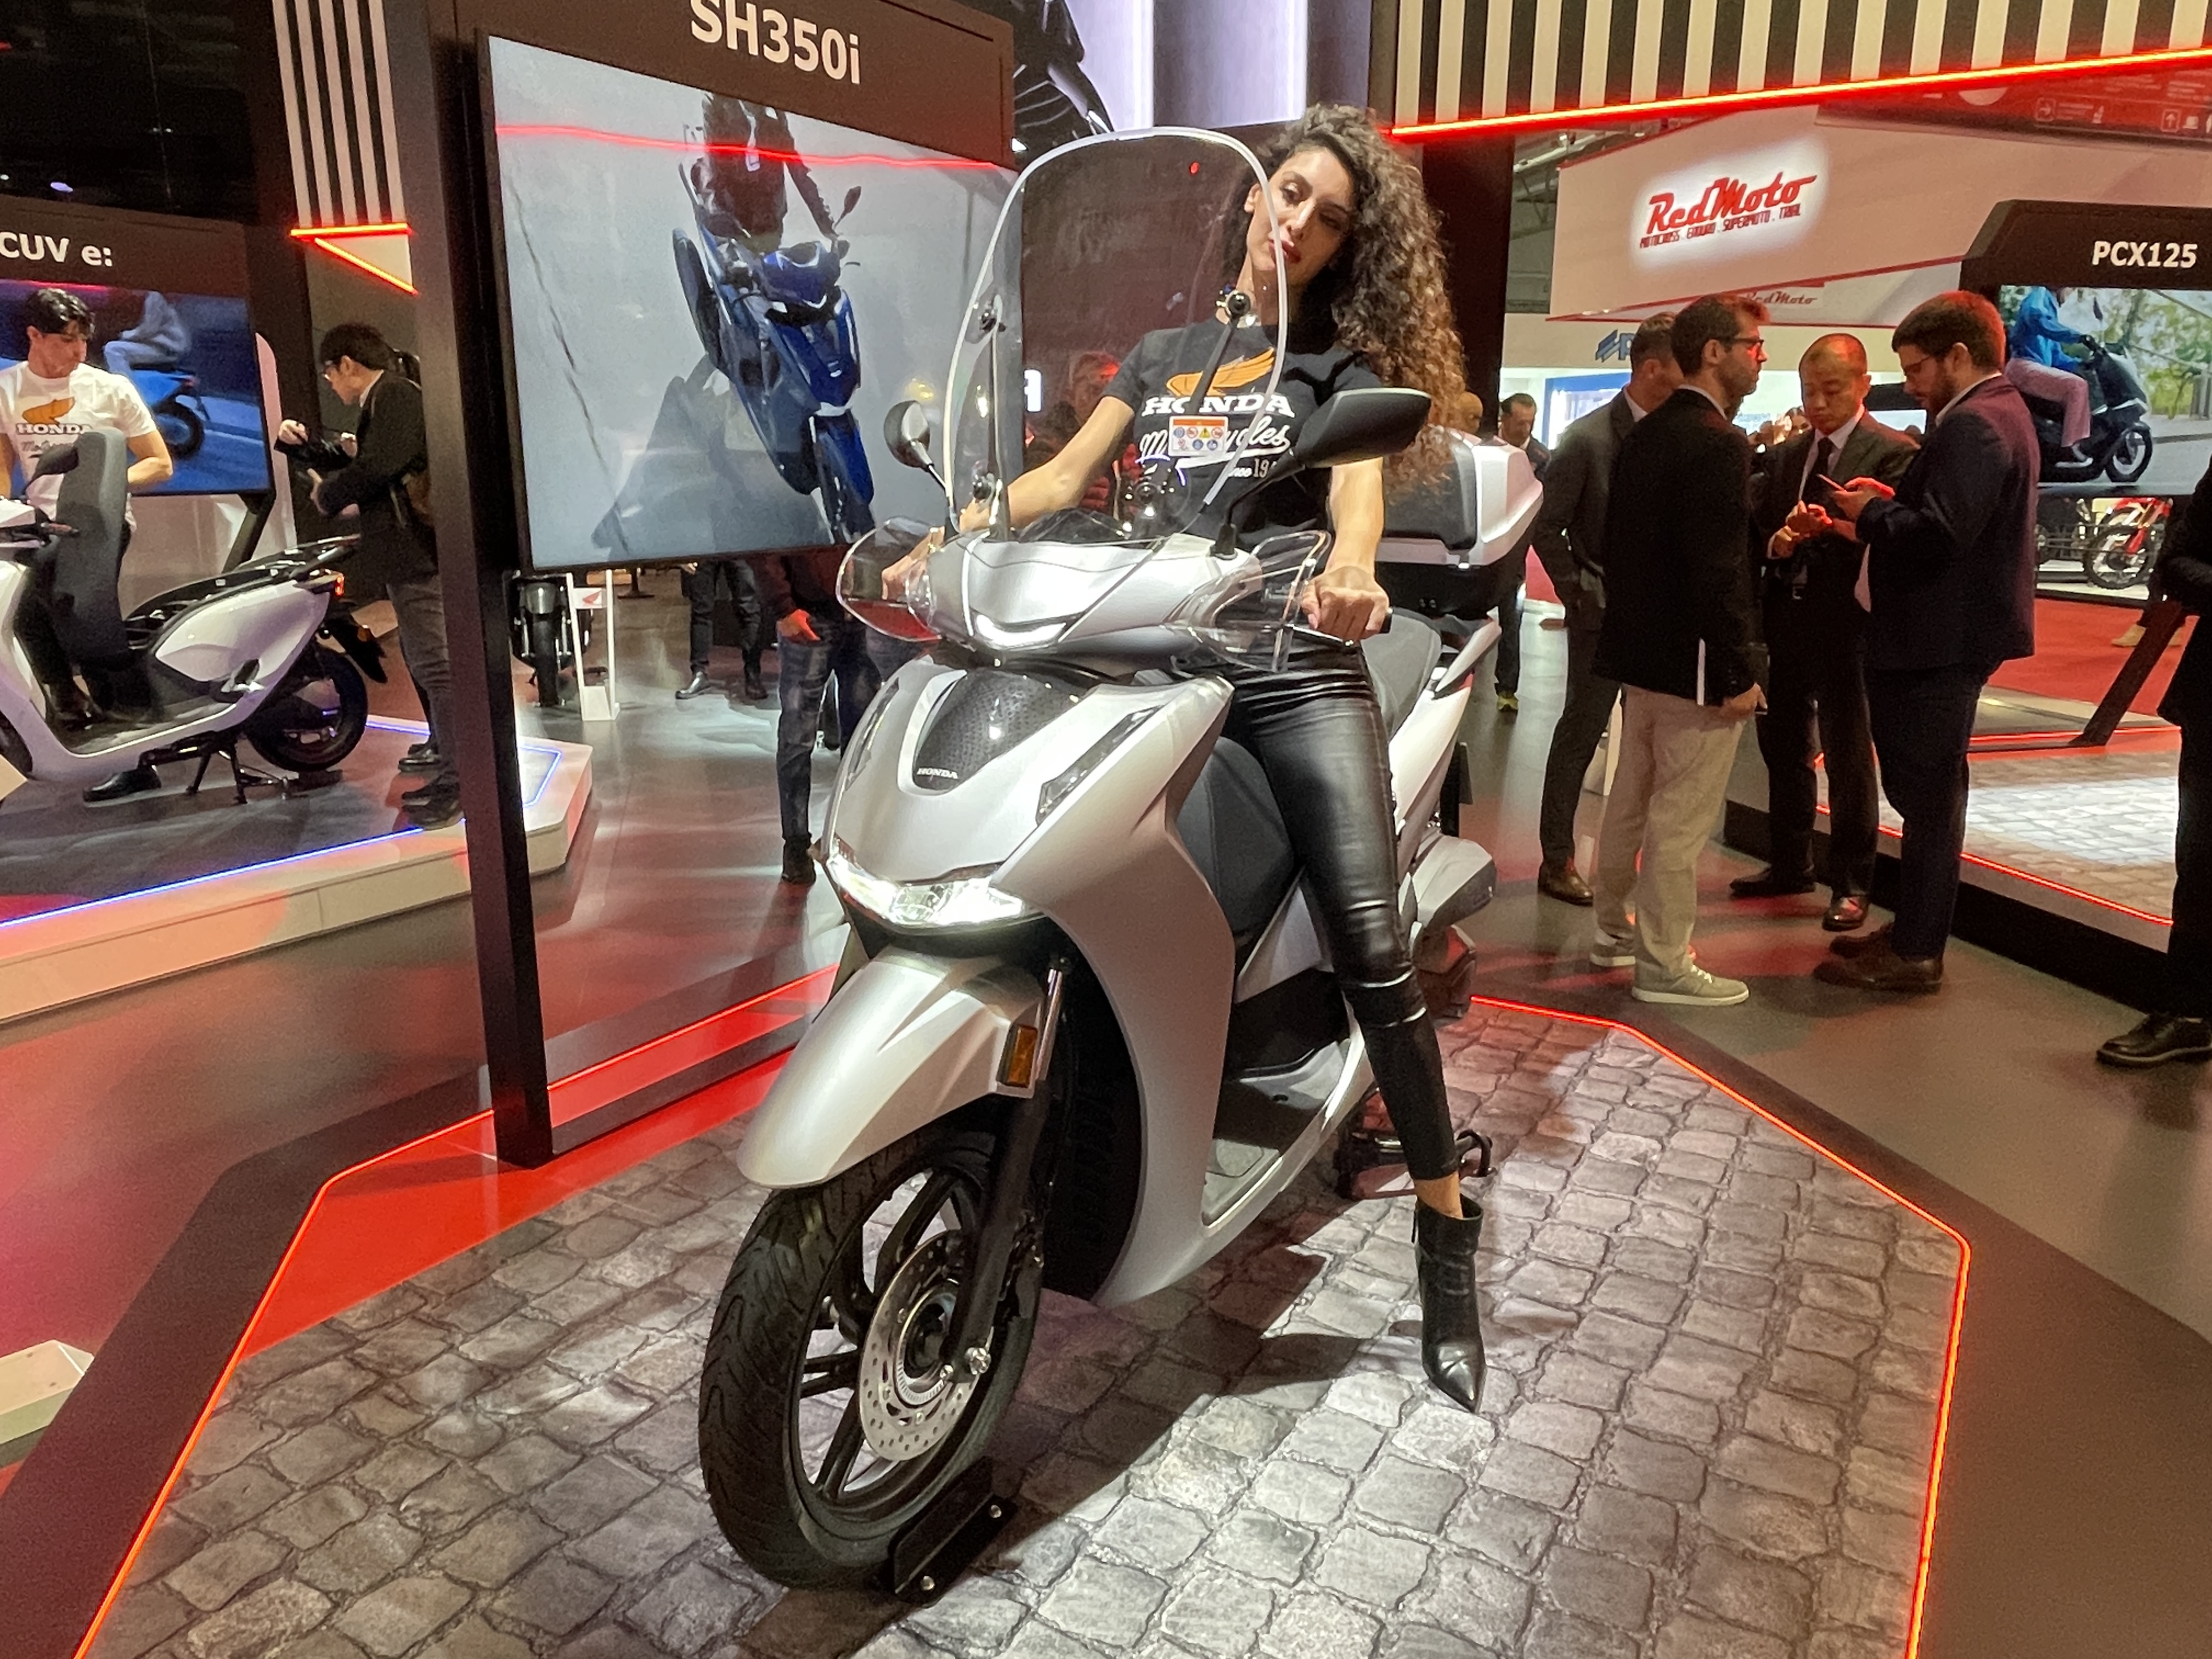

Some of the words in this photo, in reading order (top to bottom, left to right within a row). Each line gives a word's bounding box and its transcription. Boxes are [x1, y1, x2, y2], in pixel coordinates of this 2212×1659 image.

[690, 0, 860, 84] SH350i
[1648, 171, 1818, 234] RedMoto
[0, 232, 70, 262] CUV
[81, 245, 113, 267] e:
[2092, 240, 2198, 268] PCX125
[916, 767, 958, 779] HONDA
